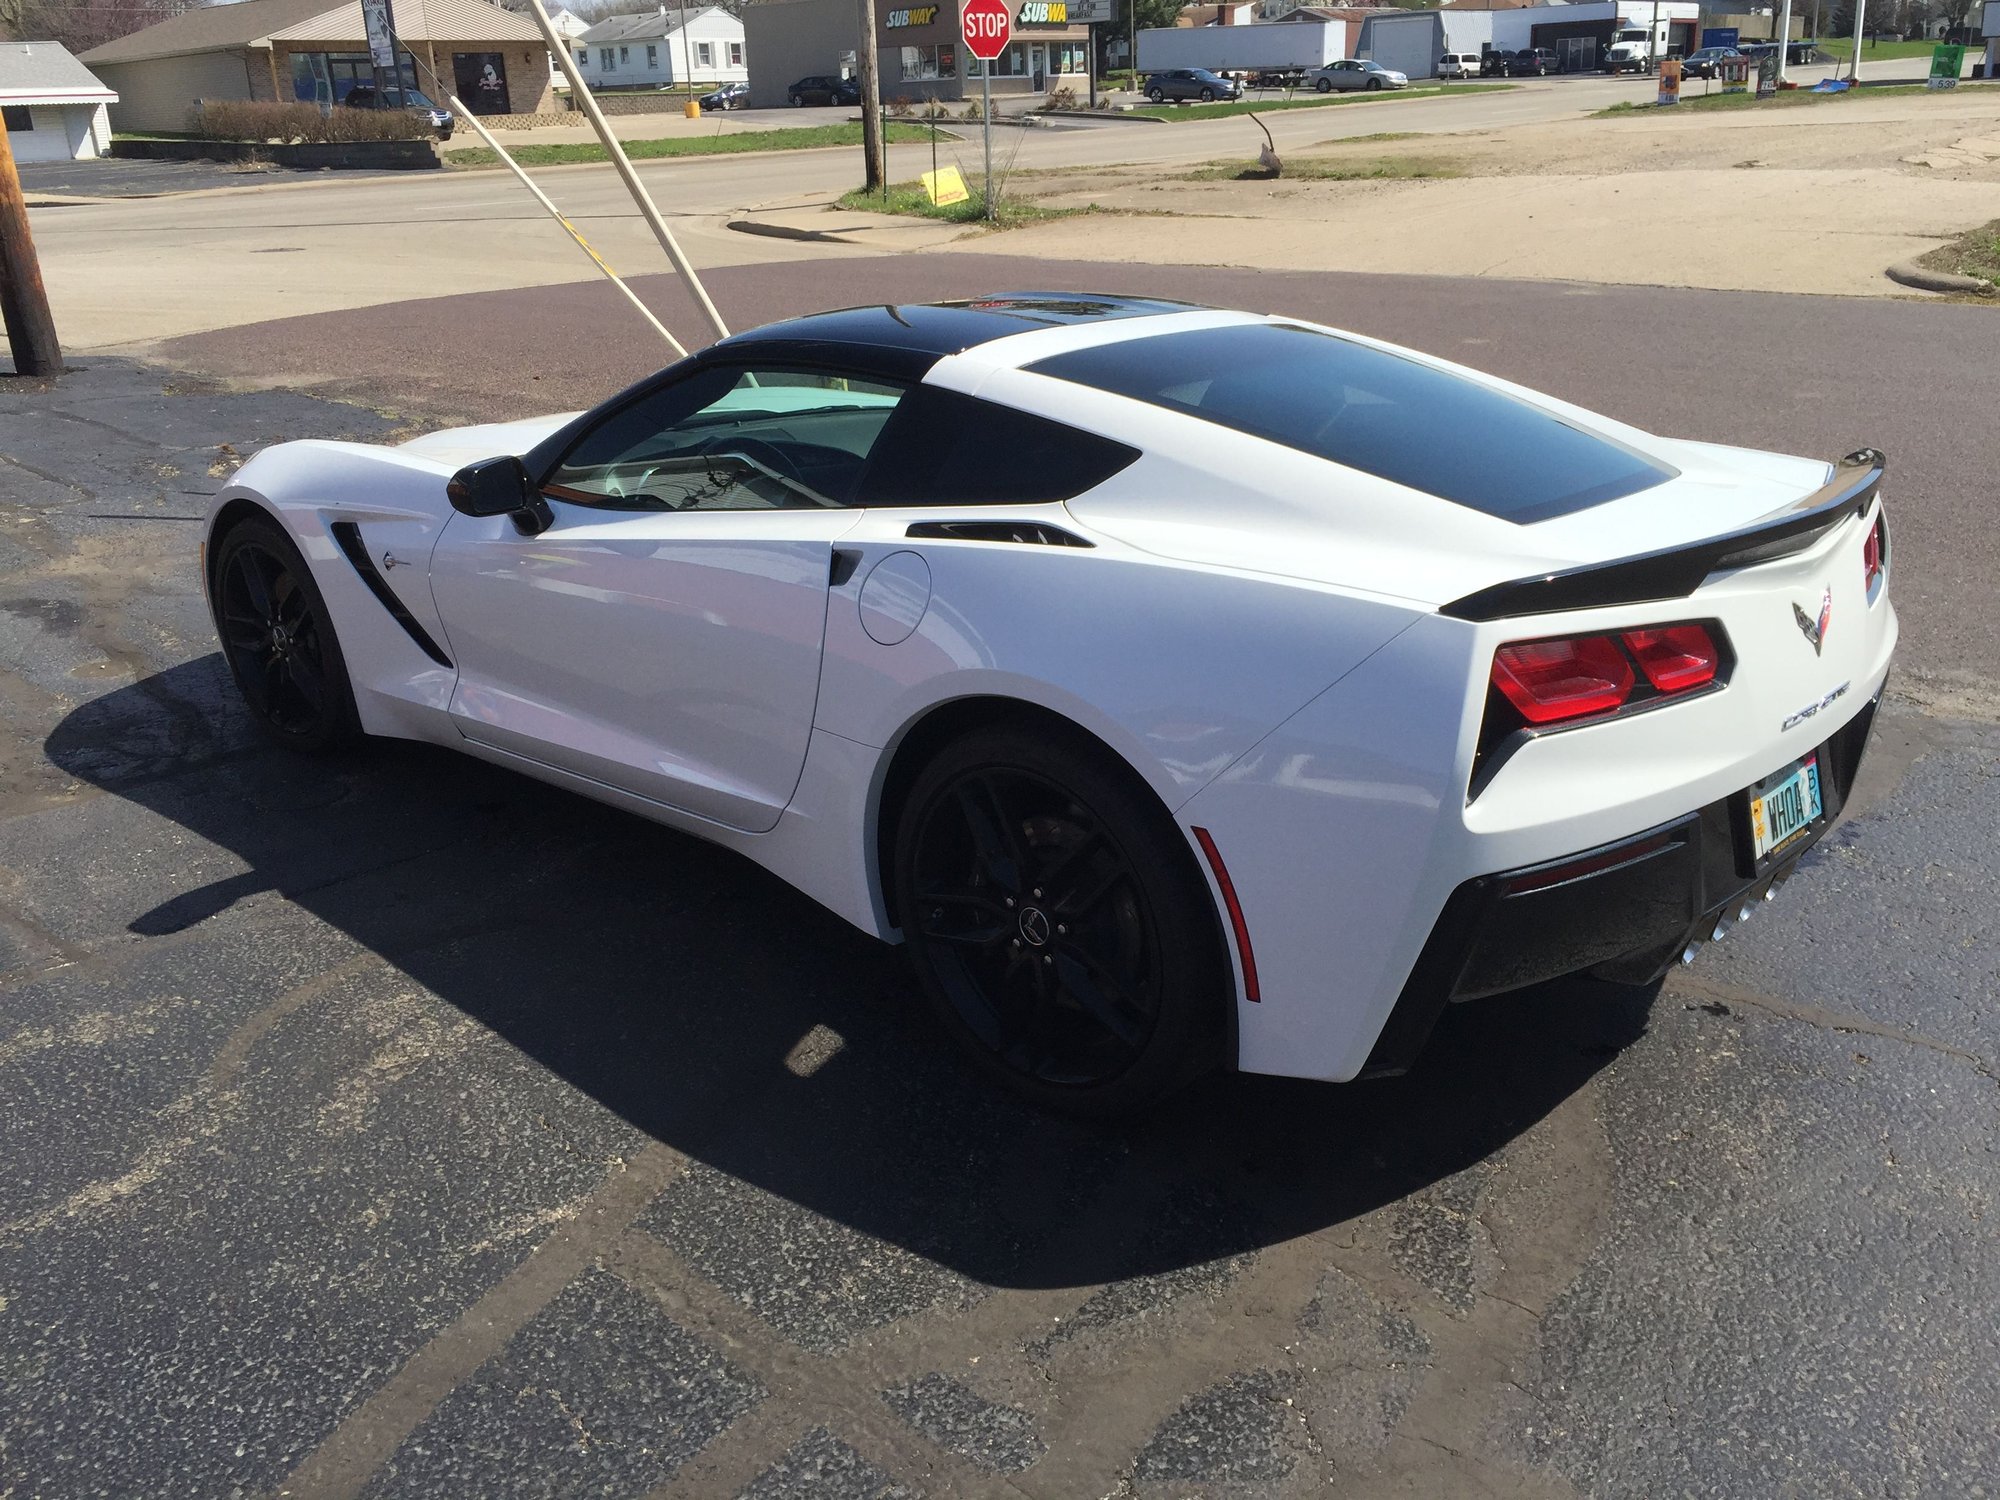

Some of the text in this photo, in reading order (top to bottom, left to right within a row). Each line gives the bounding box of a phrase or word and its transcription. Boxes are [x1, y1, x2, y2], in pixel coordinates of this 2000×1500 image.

[886, 6, 937, 28] SUBWAY
[1020, 1, 1066, 23] SUBWA
[965, 12, 1008, 39] STOP
[1767, 780, 1805, 842] WHOA
